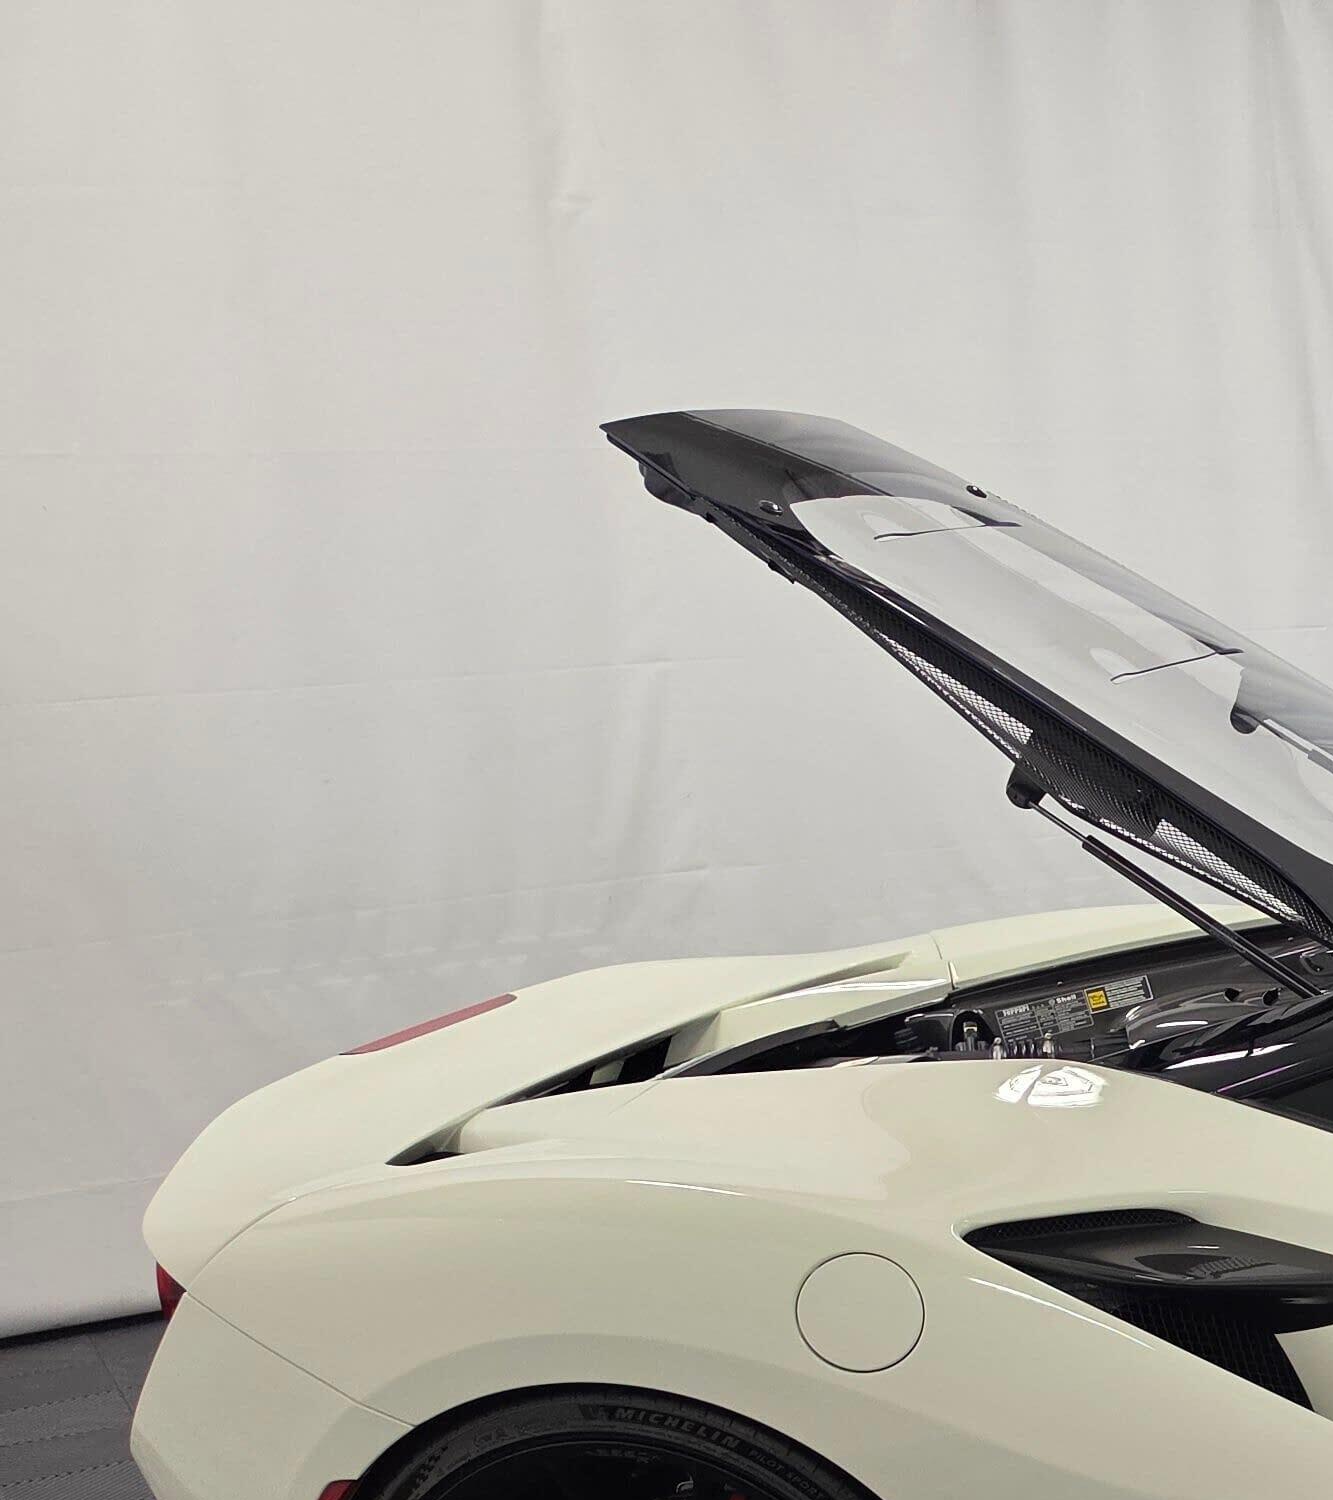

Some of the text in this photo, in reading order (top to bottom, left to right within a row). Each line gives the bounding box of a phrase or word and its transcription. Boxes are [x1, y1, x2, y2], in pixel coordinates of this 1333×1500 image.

[1055, 994, 1077, 1004] Shell
[1002, 1003, 1030, 1017] Ferrari
[614, 1407, 742, 1448] MICHELIN
[748, 1448, 785, 1471] PILOT
